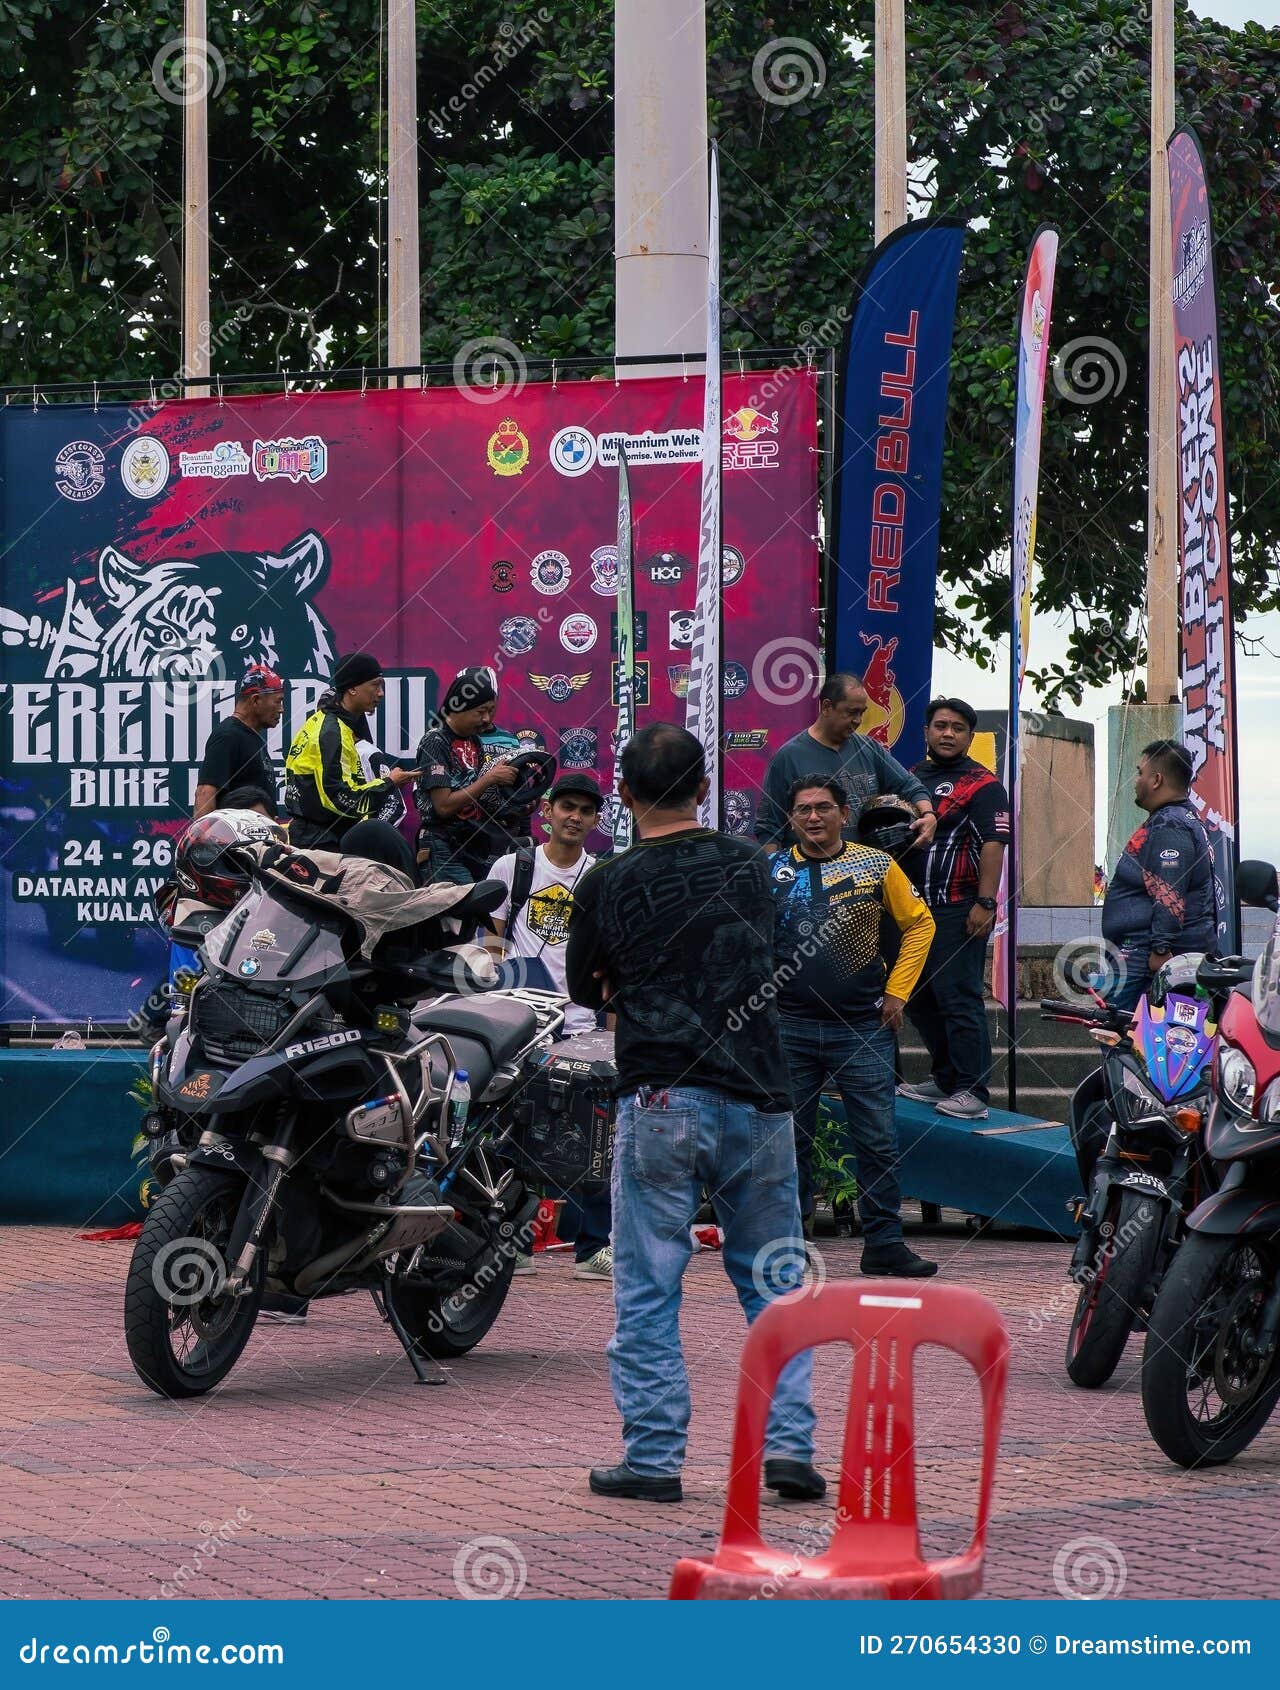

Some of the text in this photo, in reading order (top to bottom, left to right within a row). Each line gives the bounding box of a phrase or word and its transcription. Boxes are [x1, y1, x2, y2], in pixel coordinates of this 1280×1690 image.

[602, 434, 700, 450] Millennium Welt
[181, 453, 213, 462] Beautiful
[602, 449, 699, 461] We omise. We Deliver.
[867, 310, 919, 613] RED BULL
[181, 463, 248, 476] Terengganu
[61, 484, 99, 498] MALAYSIA
[1178, 341, 1207, 628] BIKERS
[651, 567, 681, 580] HOG
[70, 768, 170, 807] BIKE
[63, 839, 172, 866] 24 - 26
[18, 877, 127, 897] DATARAN
[77, 902, 155, 922] KUALA
[284, 1029, 362, 1059] R1200
[592, 1150, 603, 1178] ADV
